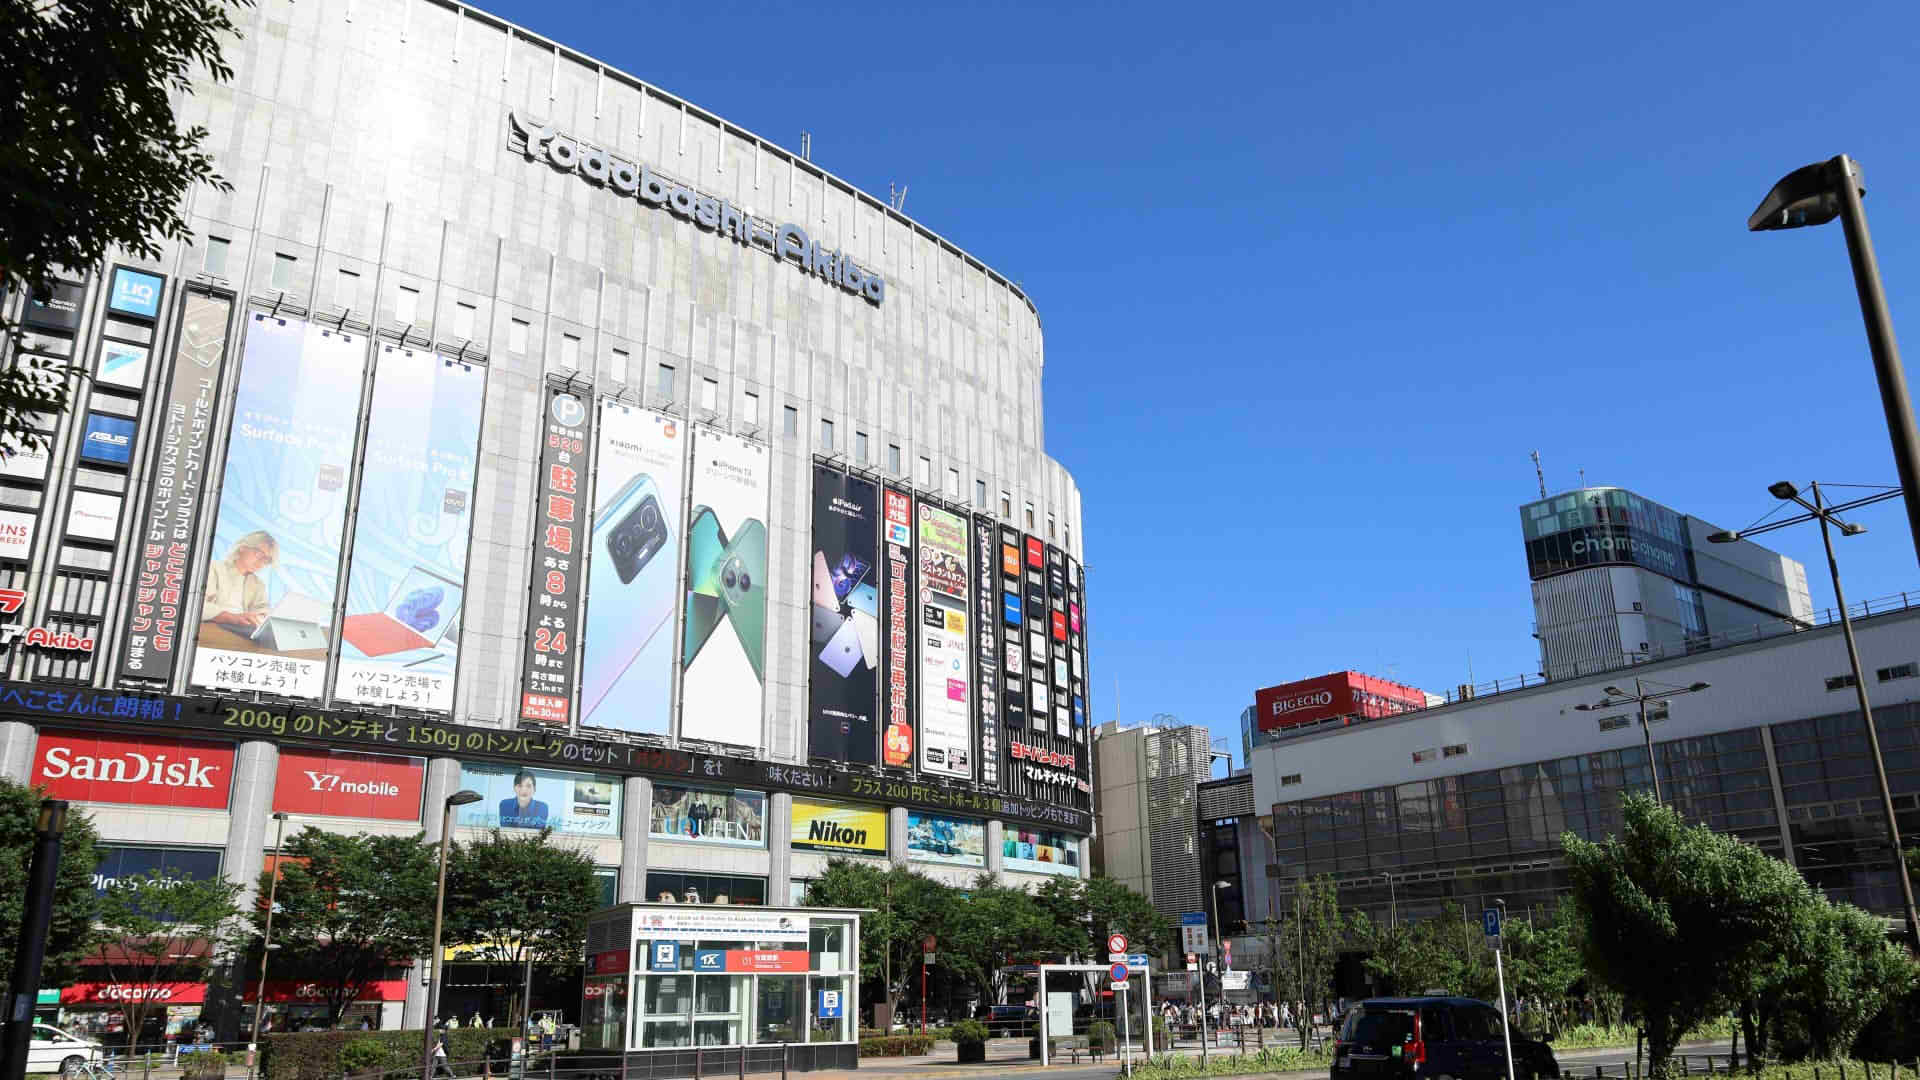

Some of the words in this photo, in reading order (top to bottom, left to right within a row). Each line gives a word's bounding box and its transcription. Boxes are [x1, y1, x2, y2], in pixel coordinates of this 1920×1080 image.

[560, 399, 578, 419] P
[88, 430, 129, 445] ASUS
[544, 556, 570, 571] あさ
[545, 570, 566, 595] 8
[26, 627, 95, 652] Akiba
[534, 627, 568, 655] 24
[209, 654, 313, 677] パソコン売場で
[351, 669, 443, 692] パソコン売場で
[1272, 701, 1297, 716] BIG
[1298, 691, 1333, 707] ECHO
[223, 707, 287, 736] 200g
[407, 726, 461, 750] 150g
[42, 746, 216, 790] SanDisk
[341, 780, 400, 798] mobile
[808, 819, 868, 847] Nikon
